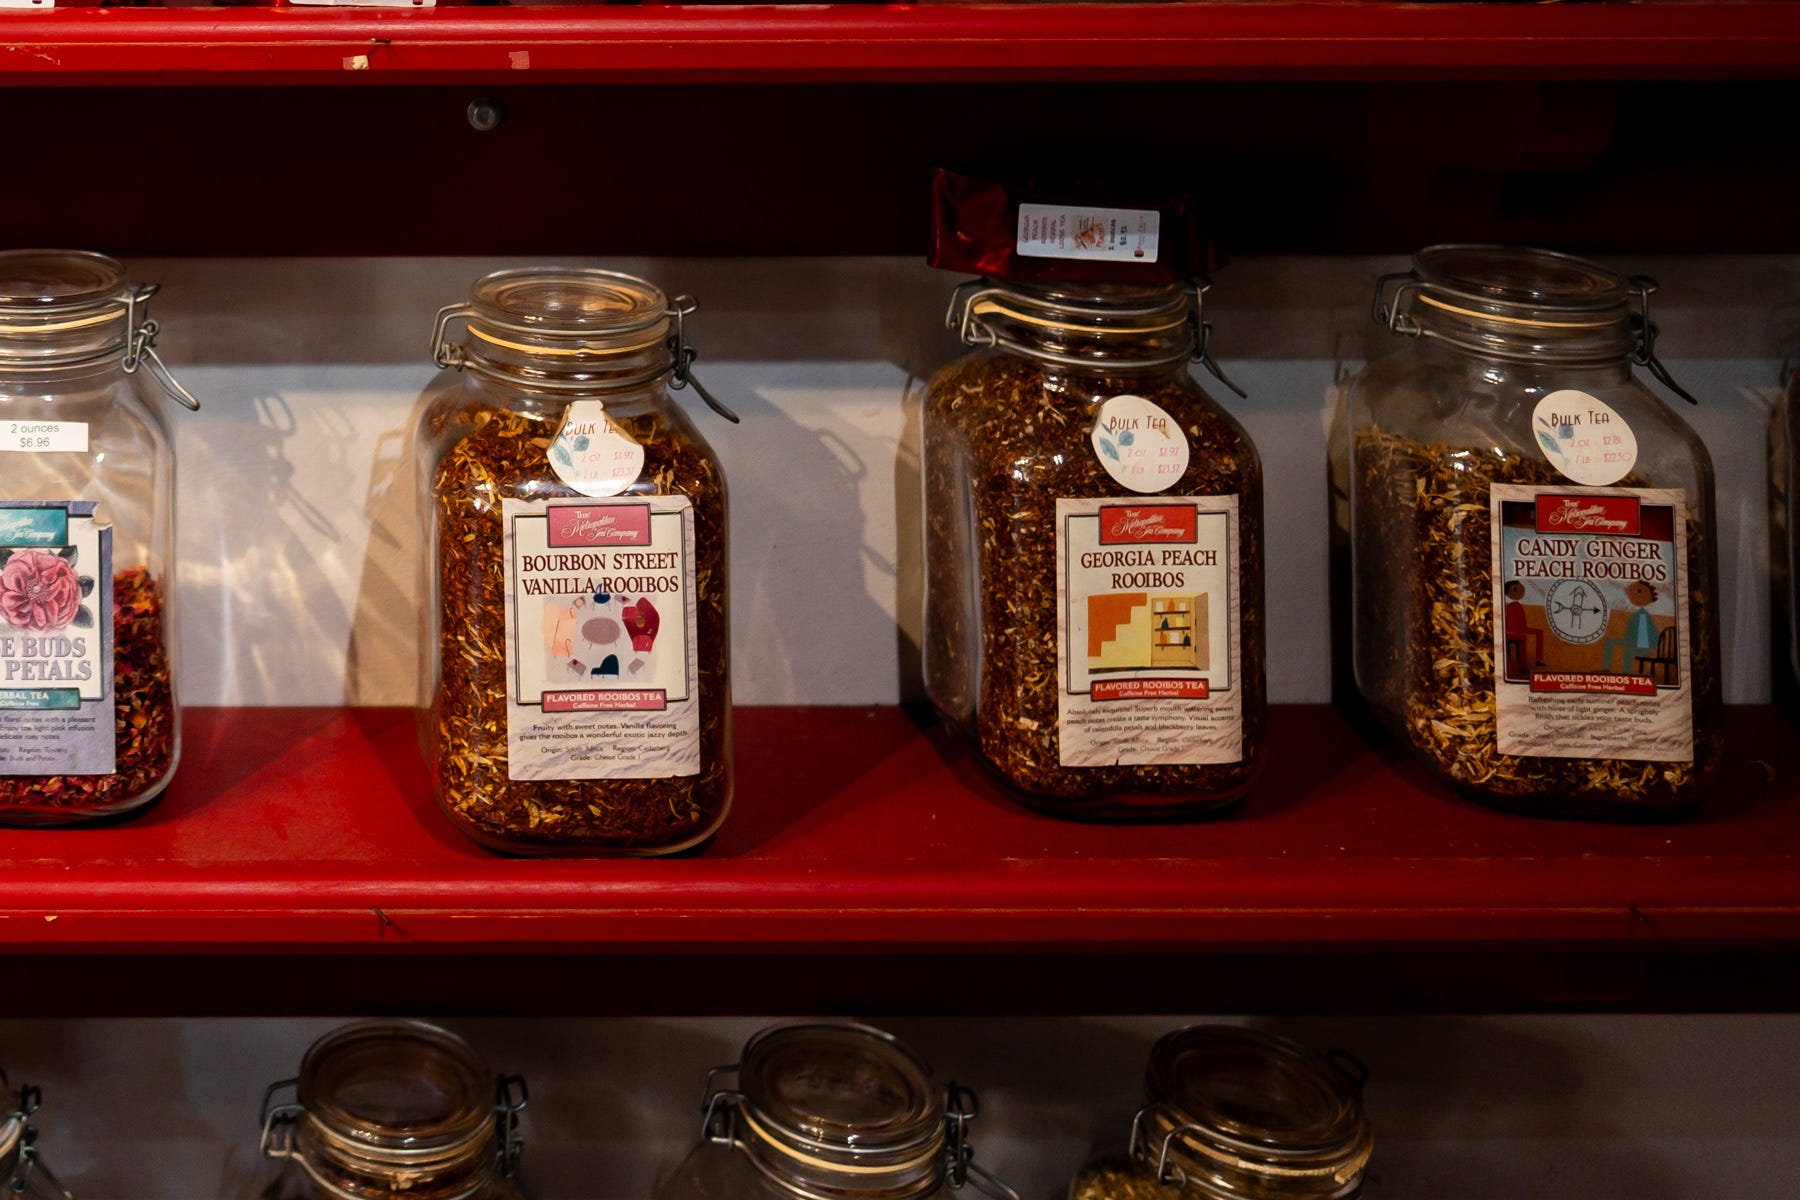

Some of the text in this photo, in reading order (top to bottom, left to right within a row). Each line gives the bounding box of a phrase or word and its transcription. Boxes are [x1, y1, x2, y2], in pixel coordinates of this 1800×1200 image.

[1109, 416, 1139, 431] BULK
[1551, 411, 1609, 427] BULK TEA
[11, 424, 59, 434] 2 ounces
[19, 437, 50, 448] $6.96
[1518, 539, 1662, 559] CANDY GINGER
[522, 552, 678, 573] BOURBON STREET
[1081, 550, 1217, 569] GEORGIA PEACH
[1513, 559, 1666, 581] PEACH ROOIBOS
[522, 576, 679, 596] VANILLA ROOIBOS
[1111, 571, 1184, 589] ROOIBOS
[21, 637, 87, 658] BUDS
[6, 660, 92, 681] PETALS
[1534, 674, 1629, 685] FLAVORED ROOIBOS
[546, 692, 641, 703] FLAVORED ROOIBOS
